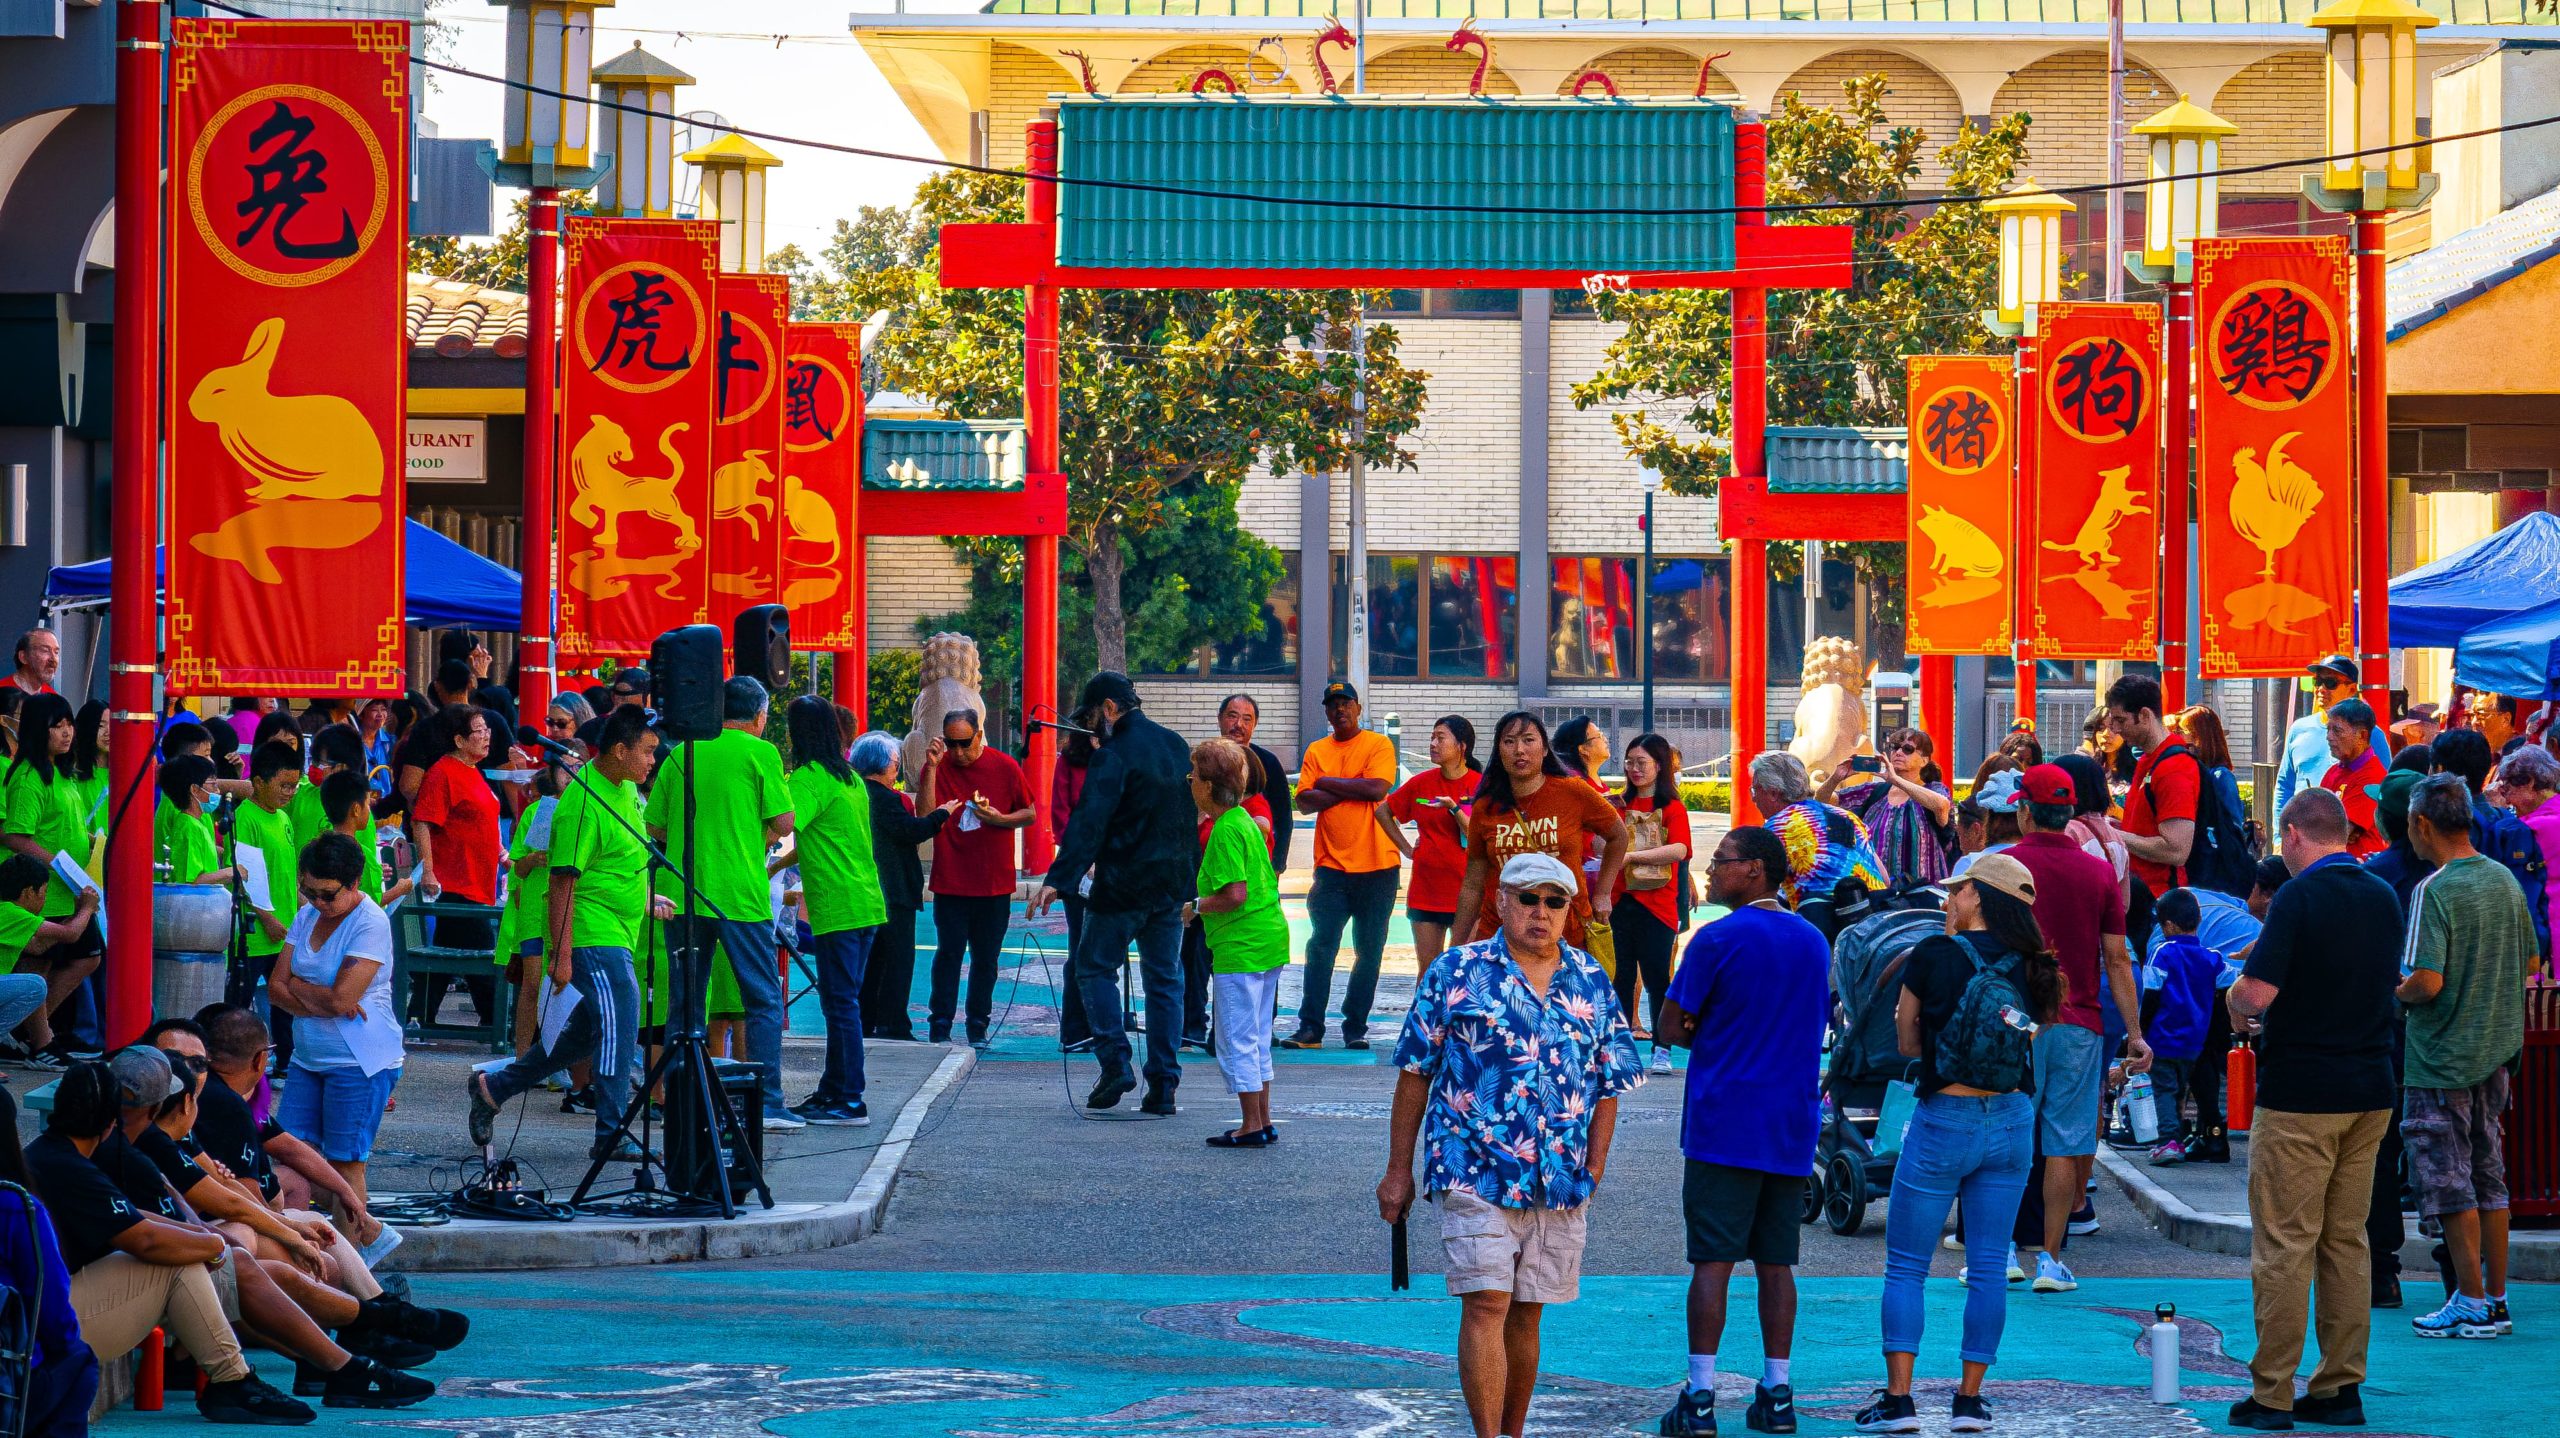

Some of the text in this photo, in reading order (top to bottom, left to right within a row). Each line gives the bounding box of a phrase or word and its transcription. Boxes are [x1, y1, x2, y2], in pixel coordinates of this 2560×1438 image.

[590, 271, 692, 373] 虎
[2057, 338, 2141, 436] 狗
[406, 433, 475, 448] URANT
[1496, 816, 1558, 837] DAWN
